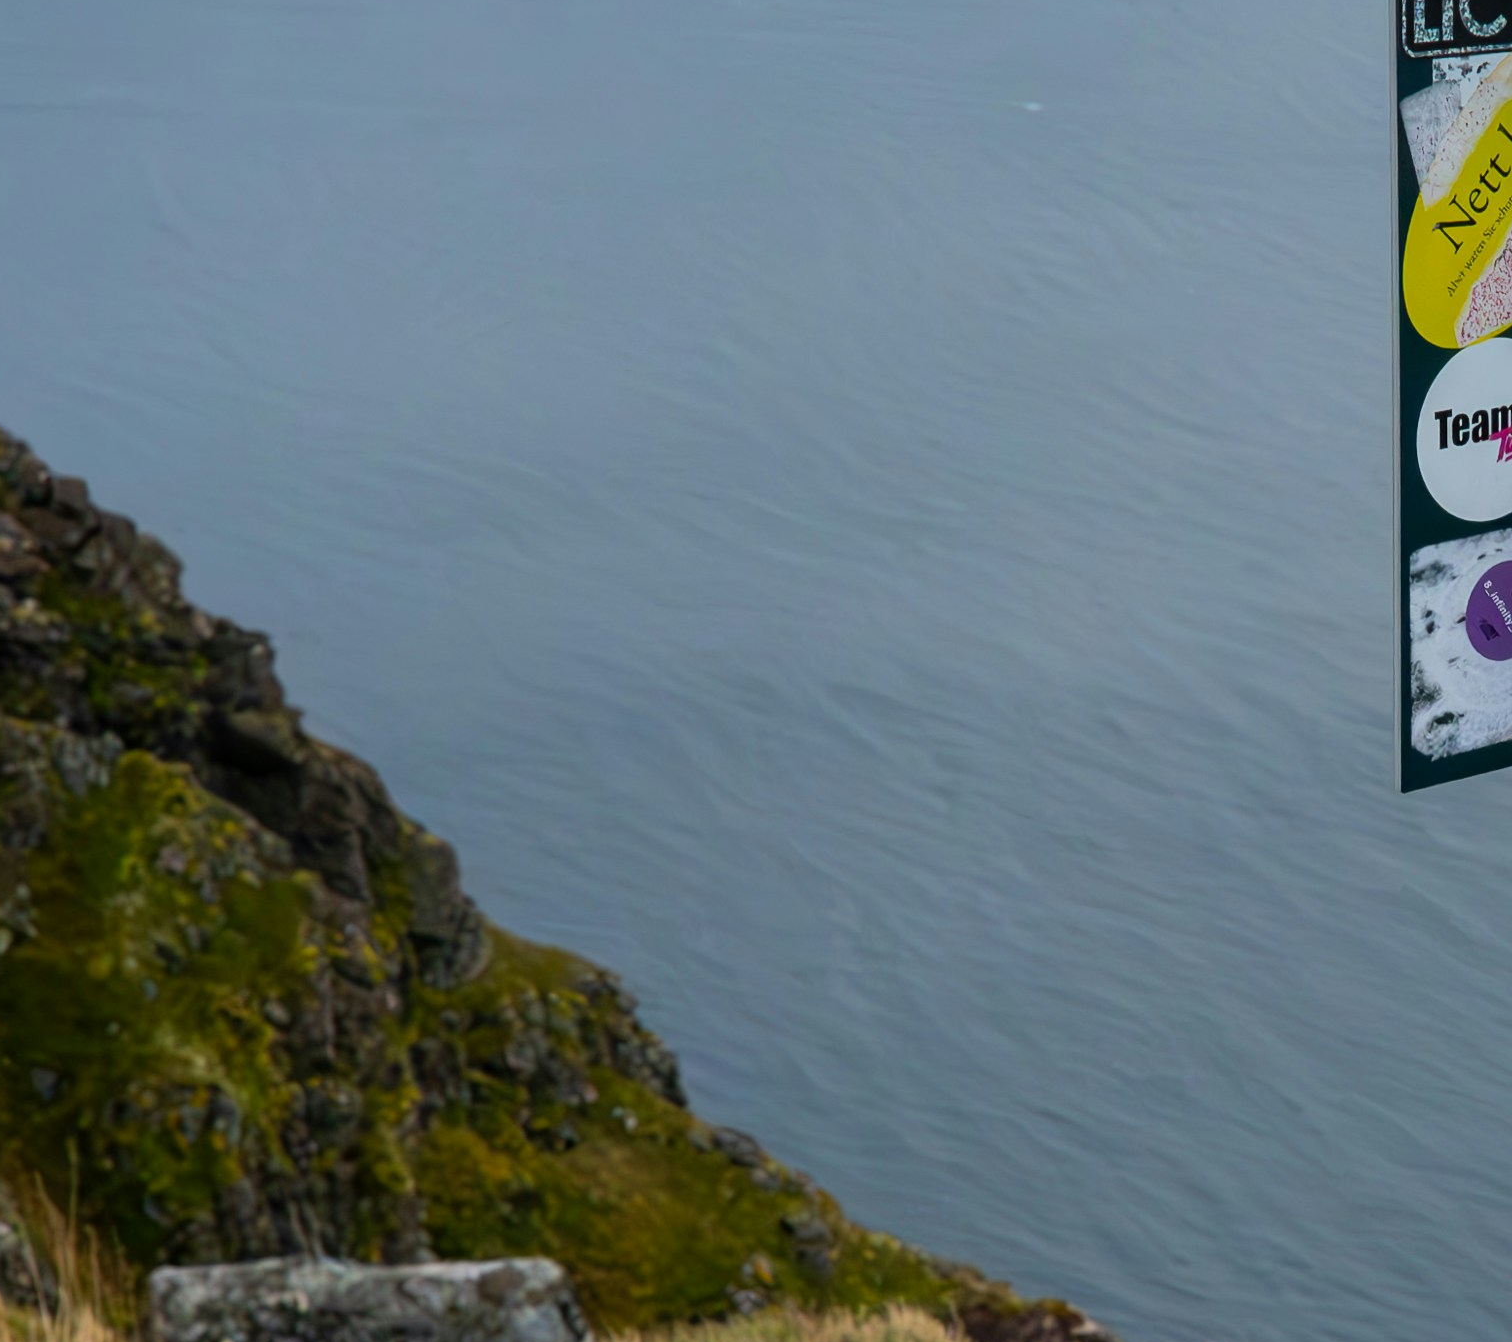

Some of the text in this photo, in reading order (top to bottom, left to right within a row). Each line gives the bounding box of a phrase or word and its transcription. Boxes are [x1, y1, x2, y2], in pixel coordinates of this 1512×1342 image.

[1432, 153, 1512, 255] Nett
[1464, 237, 1487, 271] waren
[1482, 223, 1498, 241] Sie
